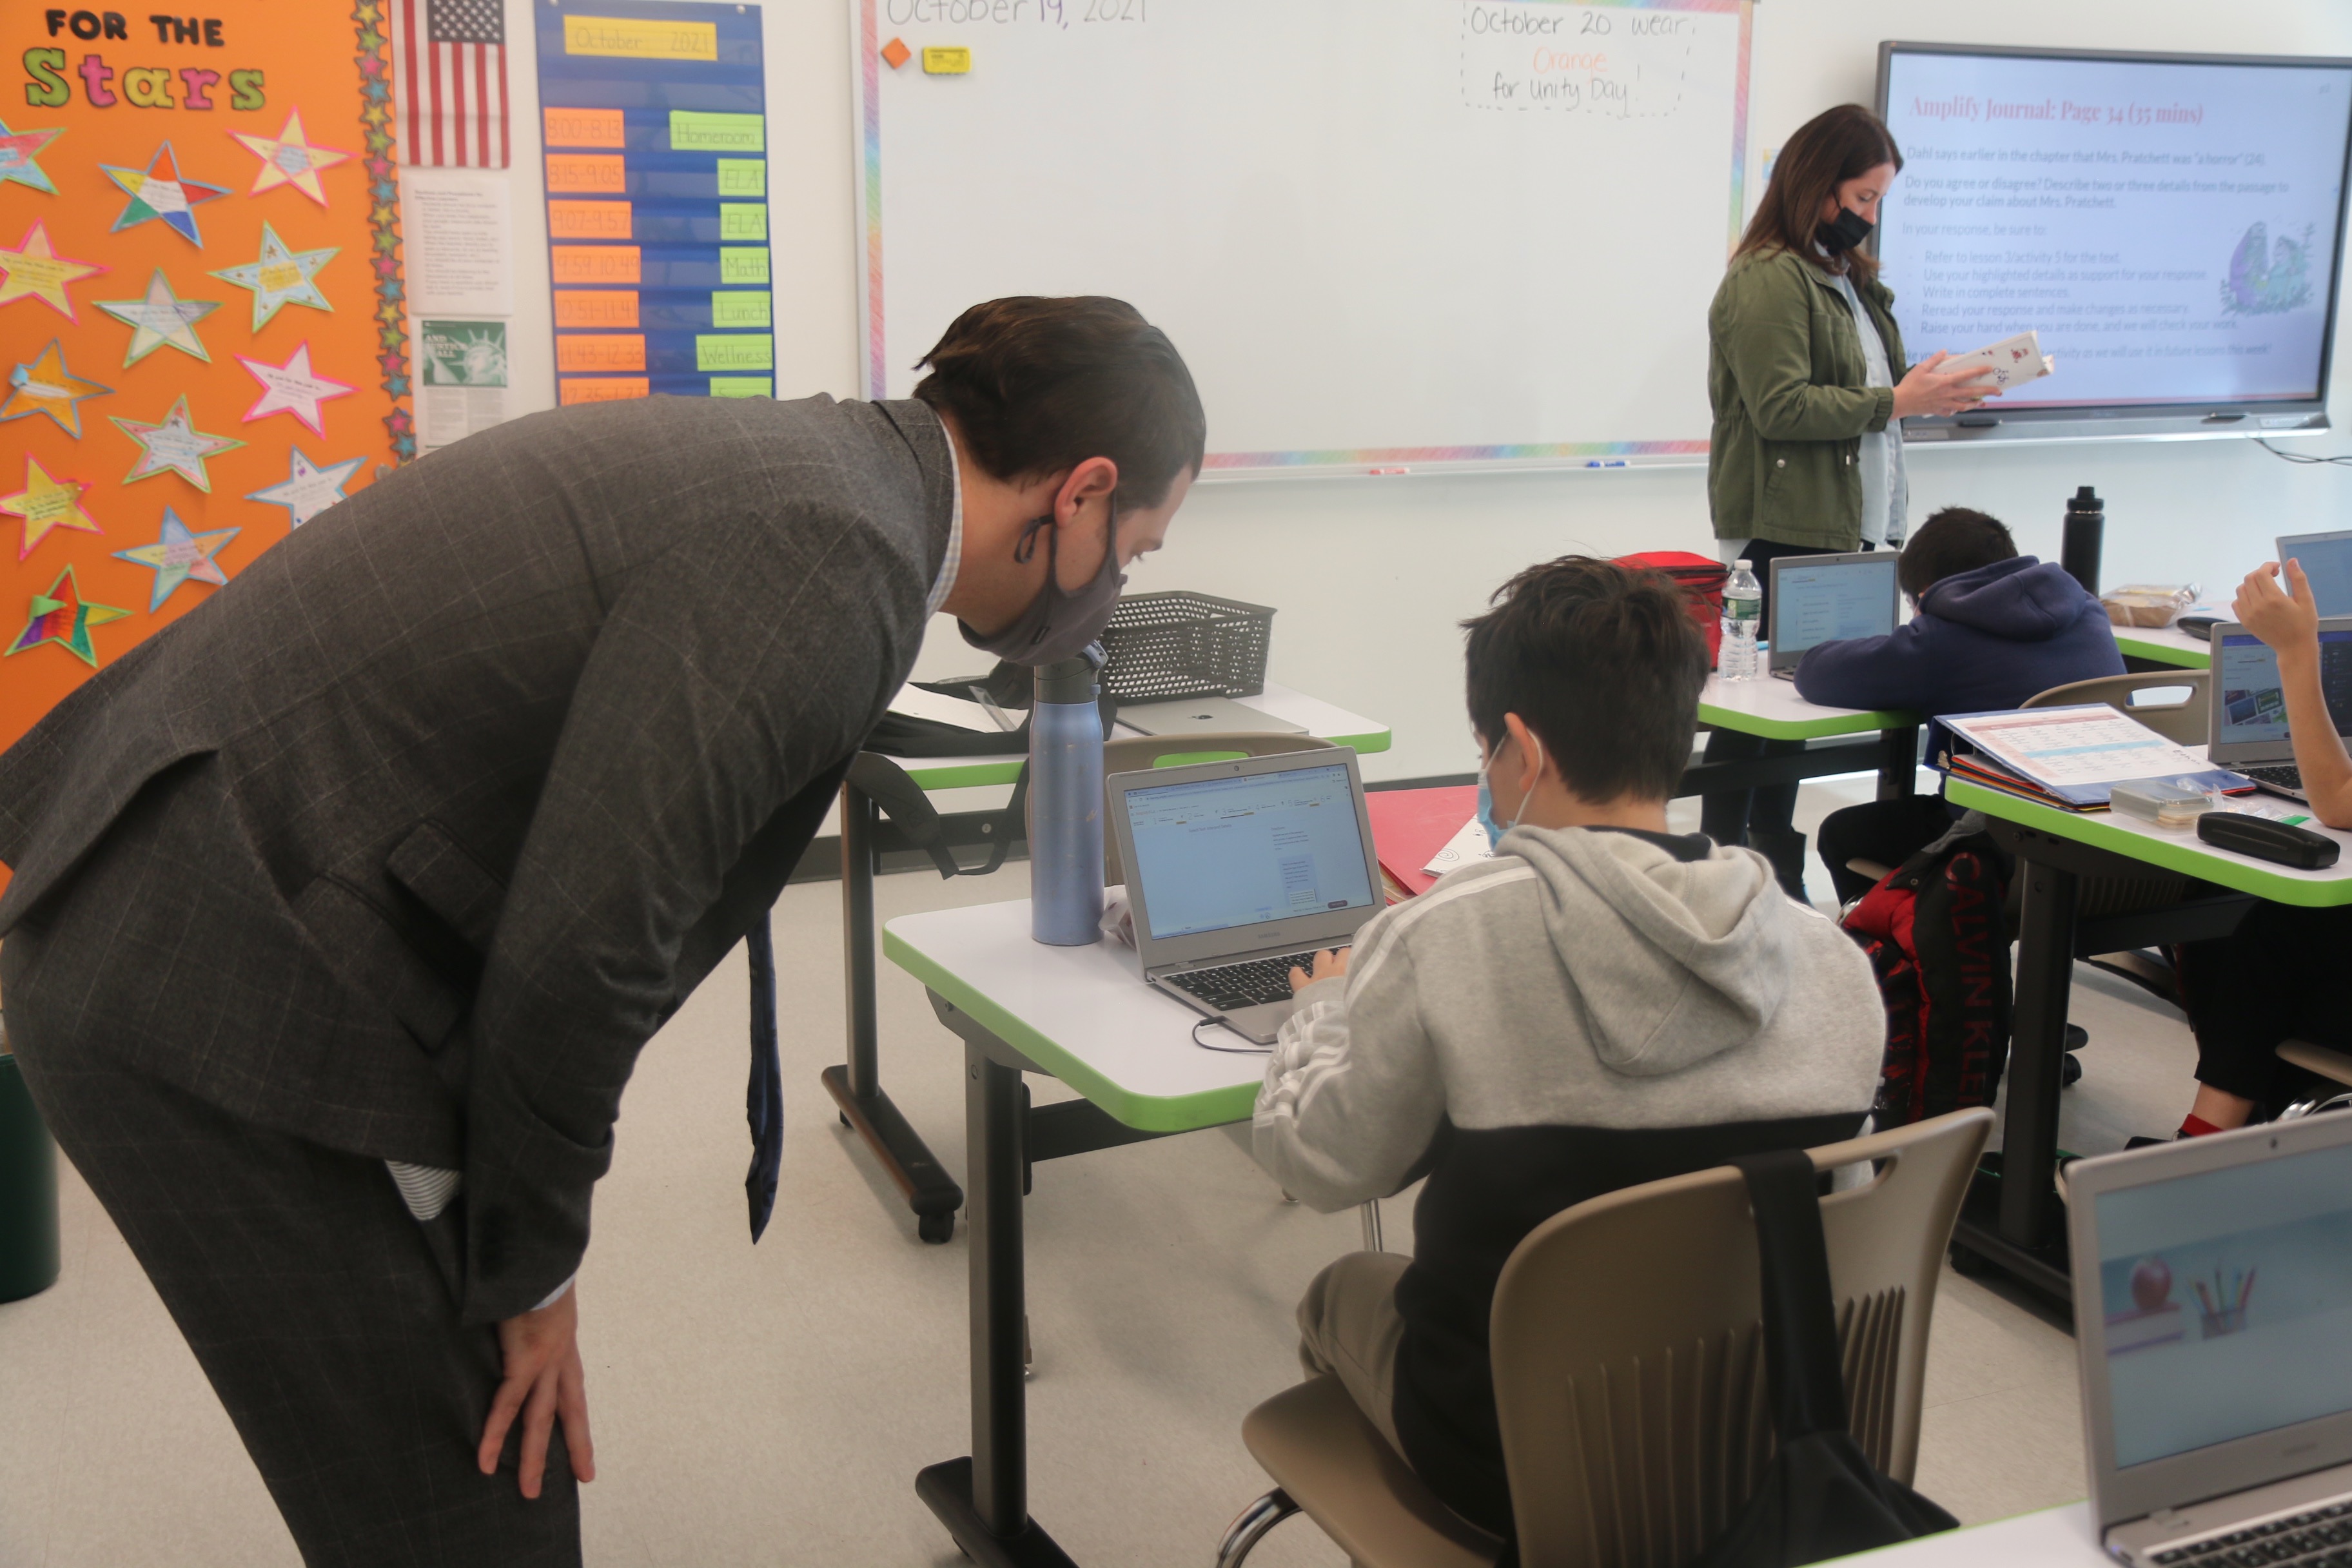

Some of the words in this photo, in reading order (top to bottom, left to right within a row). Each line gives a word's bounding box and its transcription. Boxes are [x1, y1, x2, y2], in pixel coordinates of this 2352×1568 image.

[46, 9, 128, 41] FOR
[150, 14, 225, 47] THE
[1470, 5, 1564, 35] October
[1580, 10, 1612, 35] 20
[1631, 15, 1689, 36] wear
[574, 27, 643, 50] October
[670, 30, 710, 54] 2021
[1533, 46, 1609, 84] Orange
[23, 46, 266, 111] Stars
[1492, 70, 1520, 101] for
[1529, 76, 1580, 110] Unity
[1908, 94, 1981, 122] Amplify
[1984, 97, 2056, 122] Journal:
[2061, 100, 2102, 124] Page
[2107, 107, 2124, 125] 34
[2128, 101, 2152, 126] (35
[2155, 101, 2204, 126] mins)
[677, 124, 756, 145] Homeroom
[1906, 146, 1933, 160] Dahl
[1935, 149, 1959, 162] says
[1960, 147, 1995, 161] earlier
[1997, 148, 2008, 161] in
[2010, 148, 2028, 162] the
[2029, 148, 2071, 164] chapter
[2073, 150, 2095, 163] that
[725, 168, 760, 190] ELA
[1905, 174, 1921, 189] Do
[1924, 177, 1943, 192] you
[1946, 177, 1975, 192] agree
[1978, 178, 1989, 190] or
[1991, 176, 2043, 193] disagree?
[2043, 177, 2090, 192] Describe
[2092, 179, 2113, 191] two
[2113, 181, 2126, 191] or
[2128, 179, 2157, 192] three
[2157, 179, 2191, 193] details
[2192, 179, 2218, 193] from
[2219, 179, 2235, 193] the
[2278, 180, 2290, 193] to
[1903, 193, 1948, 208] develop
[1949, 196, 1974, 209] your
[1975, 194, 2005, 207] claim
[2006, 194, 2037, 208] about
[726, 212, 765, 234] ELA
[1902, 222, 1913, 235] In
[1915, 224, 1939, 237] your
[1941, 224, 1992, 237] response,
[1994, 222, 2006, 236] be
[2008, 225, 2031, 236] sure
[725, 257, 769, 278] Math
[1925, 250, 1954, 264] Refer
[1956, 250, 1968, 264] to
[1969, 250, 2003, 264] lesson
[2063, 250, 2078, 264] for
[2080, 250, 2097, 264] the
[1923, 269, 1944, 282] Use
[1946, 271, 1970, 283] your
[1971, 268, 2030, 284] highlighted
[2032, 269, 2065, 282] details
[2067, 271, 2079, 282] as
[2080, 270, 2121, 283] support
[2121, 268, 2136, 282] for
[2137, 270, 2160, 283] your
[1923, 285, 1954, 299] Write
[1956, 286, 1966, 299] in
[1967, 286, 2015, 300] complete
[720, 301, 769, 321] Lunch
[1921, 303, 1959, 317] Reread
[1961, 306, 1984, 318] your
[1986, 306, 2034, 318] response
[2035, 303, 2055, 316] and
[2057, 303, 2084, 316] make
[2084, 302, 2126, 317] changes
[2127, 305, 2139, 315] as
[1921, 320, 1949, 334] Raise
[1951, 324, 1975, 336] your
[1976, 320, 2003, 334] hand
[2004, 321, 2033, 333] when
[2034, 323, 2055, 335] you
[2057, 322, 2072, 333] are
[2102, 320, 2122, 332] and
[2124, 322, 2139, 332] we
[2140, 319, 2157, 331] will
[702, 344, 772, 365] Wellness
[1945, 850, 1992, 1008] CALVIN
[1954, 1021, 1993, 1111] KLEI
